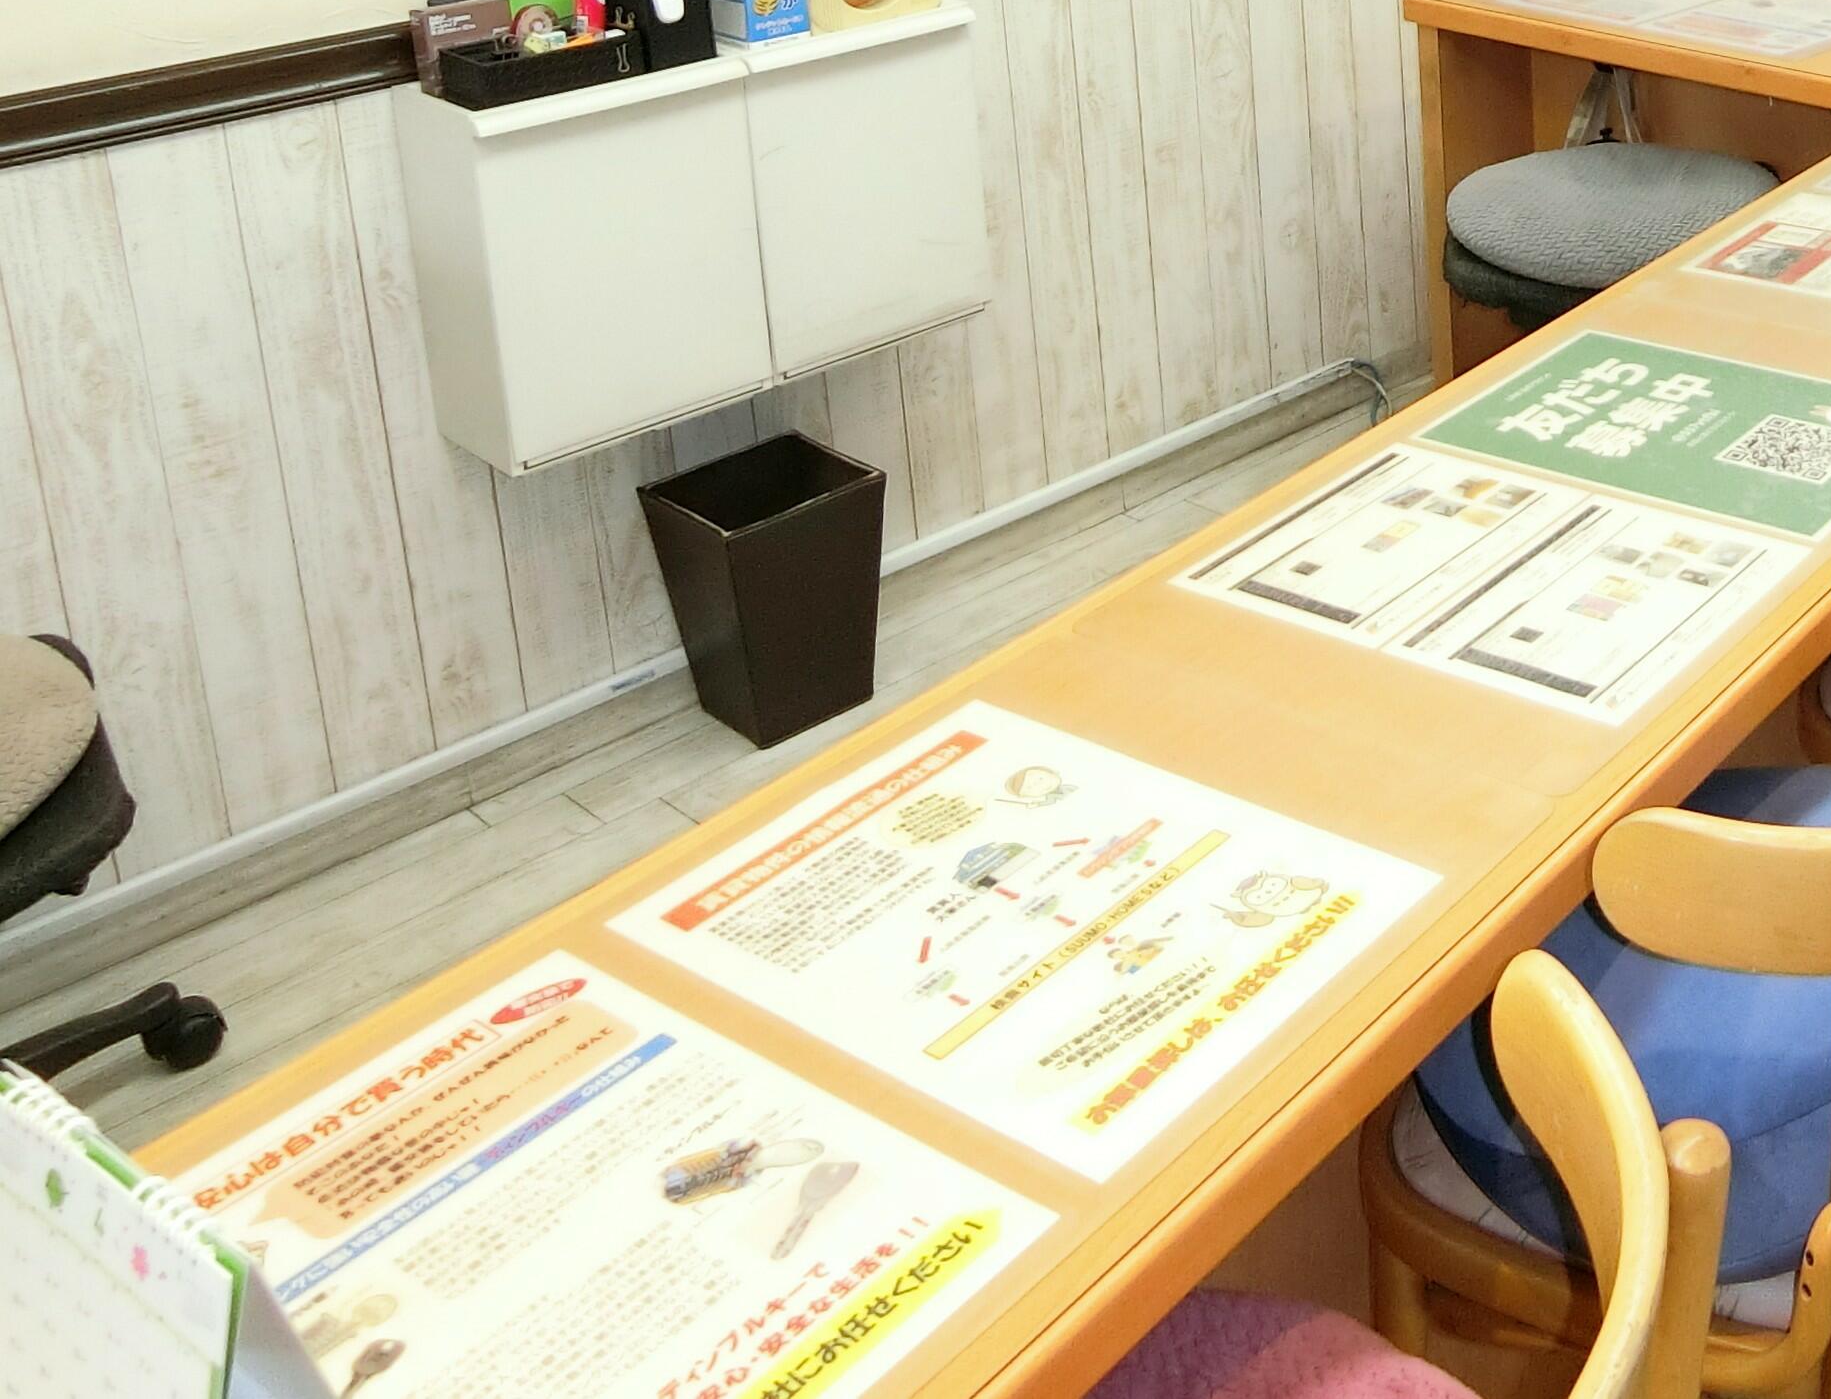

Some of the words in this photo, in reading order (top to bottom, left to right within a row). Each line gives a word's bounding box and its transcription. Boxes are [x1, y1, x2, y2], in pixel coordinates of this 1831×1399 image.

[1497, 357, 1650, 442] 友だち
[1564, 372, 1715, 459] 募集中
